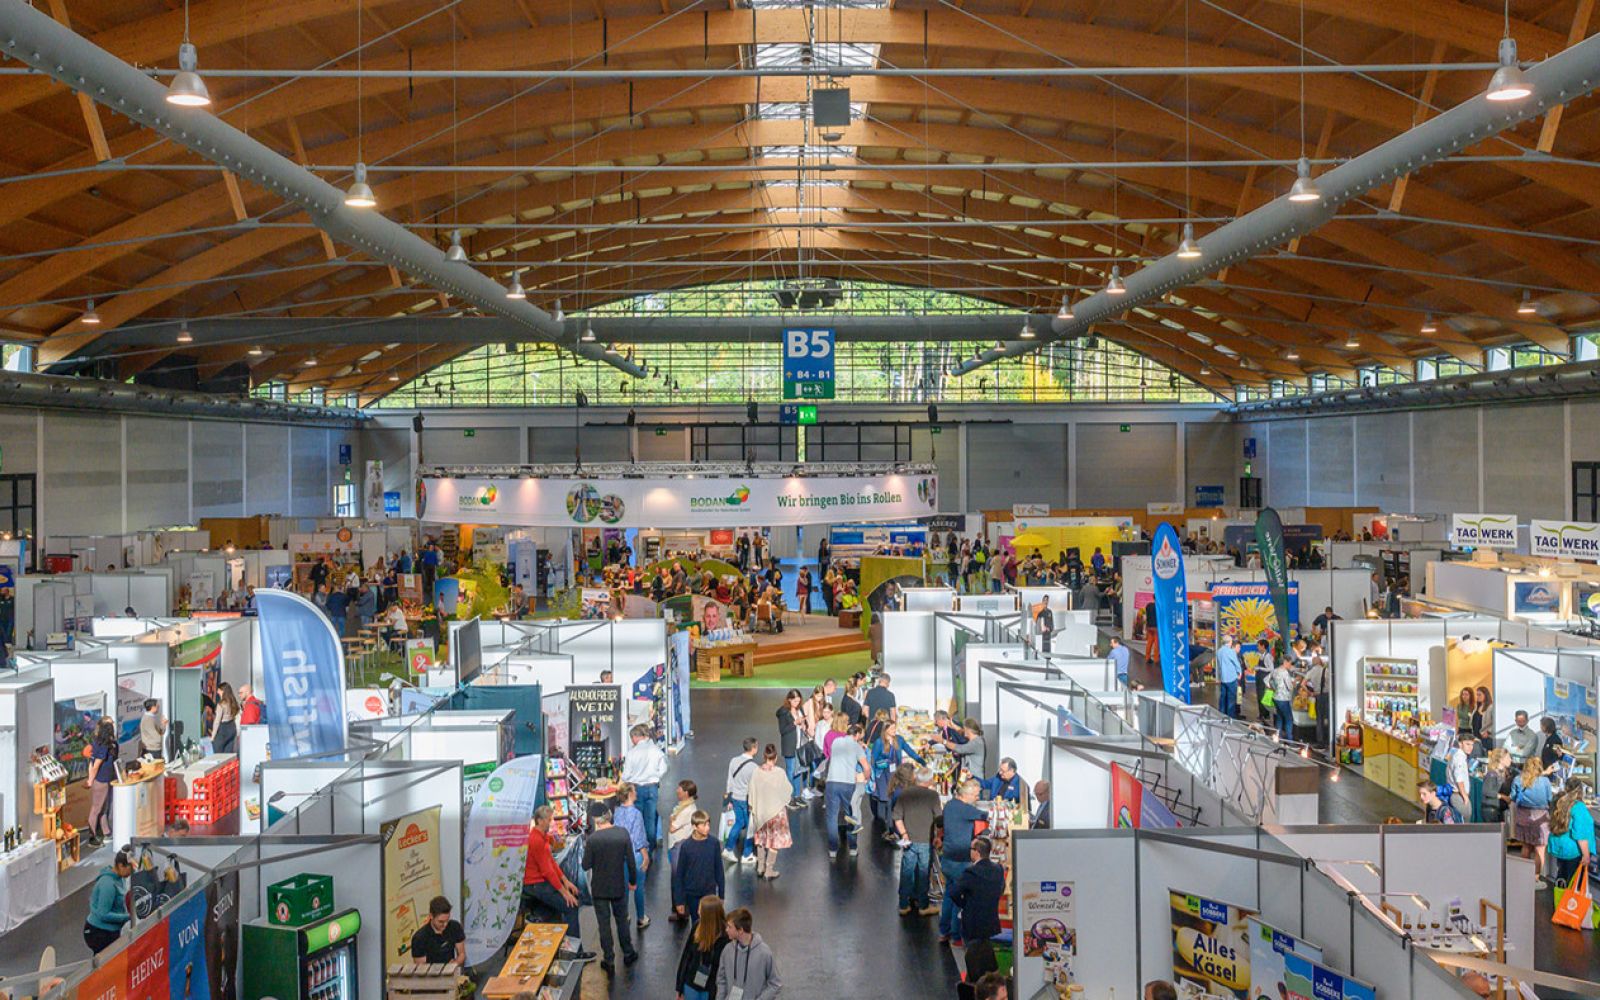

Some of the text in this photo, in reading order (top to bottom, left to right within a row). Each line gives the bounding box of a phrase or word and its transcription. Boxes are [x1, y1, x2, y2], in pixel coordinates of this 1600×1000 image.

[788, 331, 830, 358] B5
[797, 370, 809, 379] B4
[818, 370, 830, 379] B1
[690, 497, 727, 507] BODAN
[777, 492, 902, 509] Wir bringen Bio ins Rollen
[575, 702, 615, 712] WEIN
[213, 890, 234, 922] STEIN
[178, 919, 199, 948] VON
[1193, 933, 1236, 960] Alles
[131, 948, 165, 989] HEINZ
